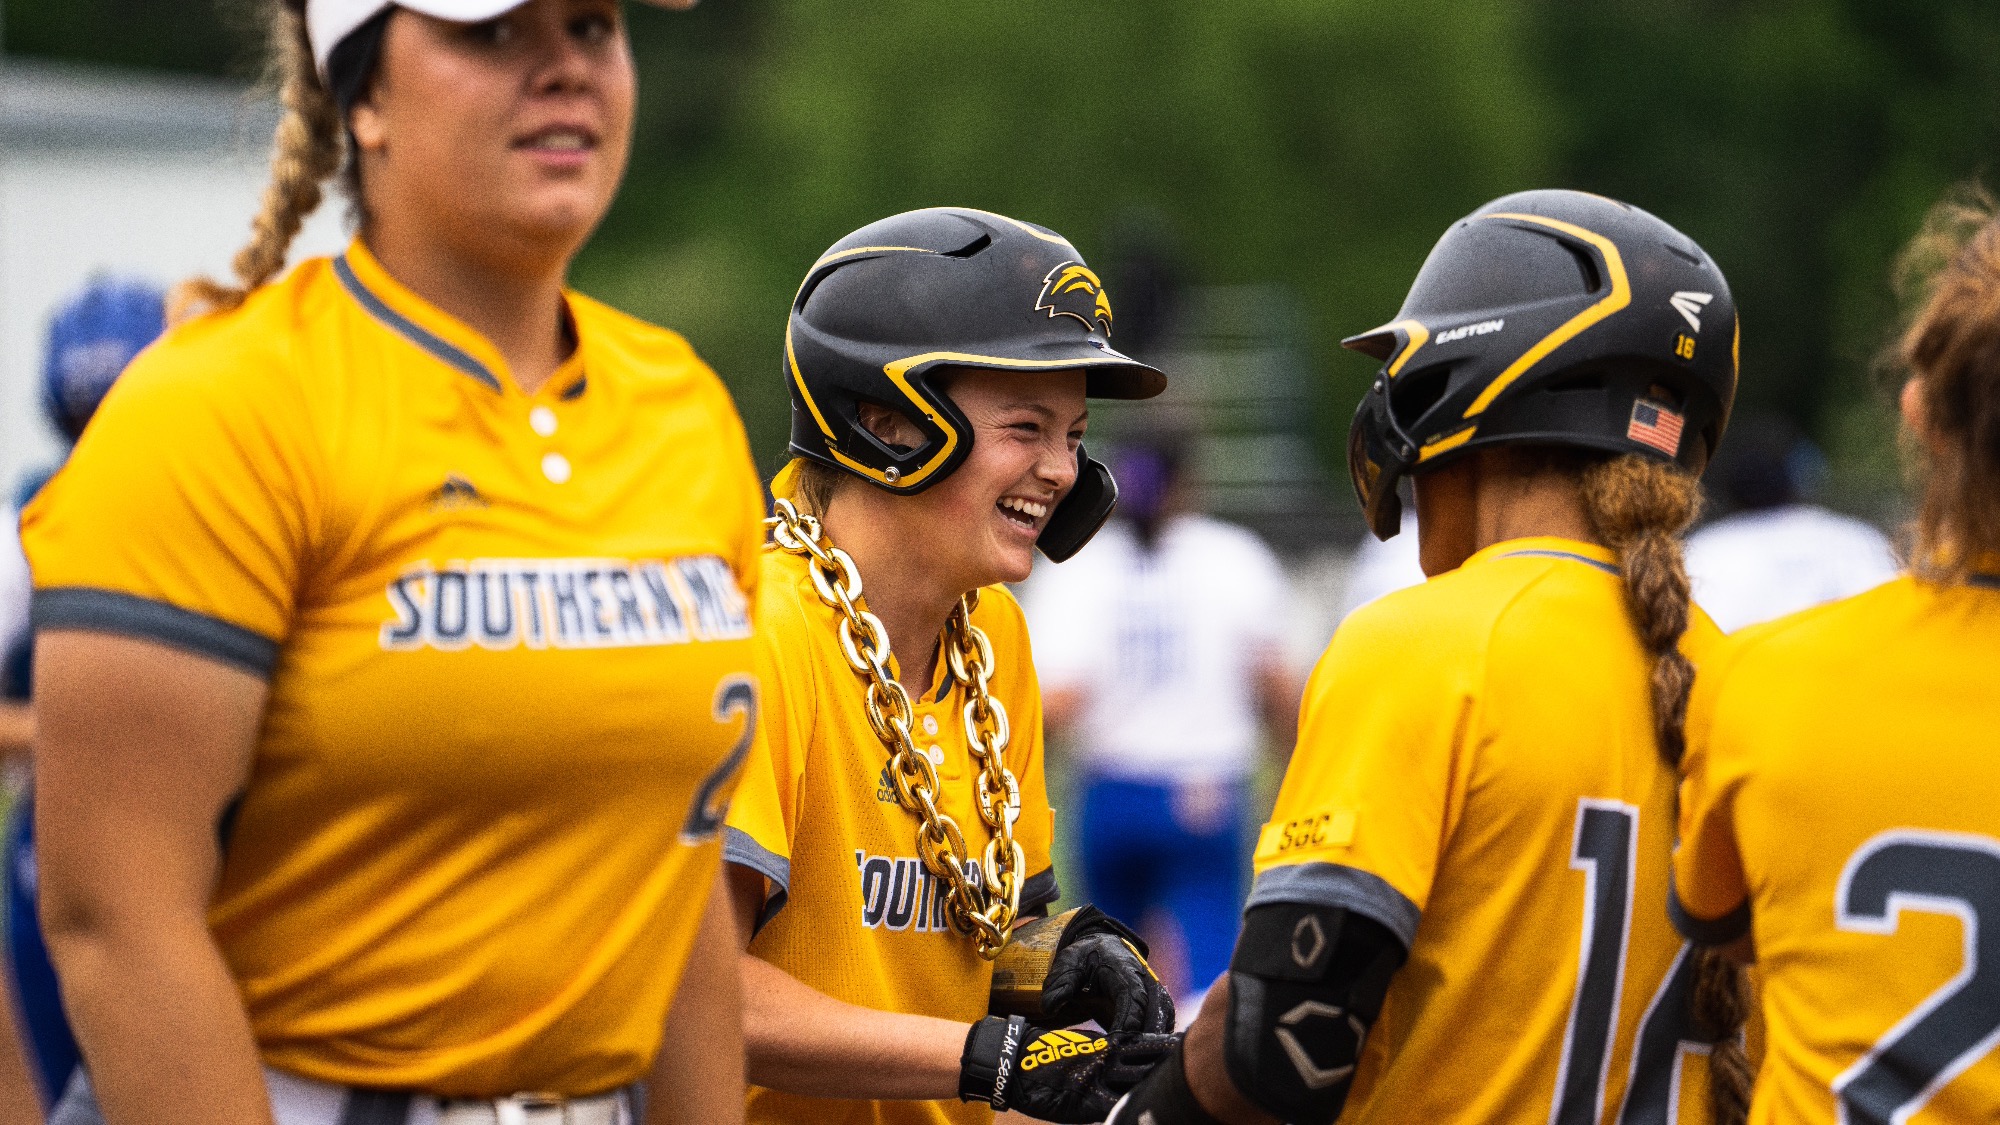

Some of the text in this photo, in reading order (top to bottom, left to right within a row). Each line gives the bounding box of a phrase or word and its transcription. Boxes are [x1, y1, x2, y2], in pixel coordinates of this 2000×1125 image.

[1435, 318, 1505, 346] EASTON
[1675, 333, 1697, 361] 16
[379, 558, 692, 651] SOUTHERN
[678, 671, 760, 847] 2
[1279, 814, 1331, 852] SGC
[992, 1023, 1020, 1108] I AM SECOND
[1020, 1036, 1108, 1072] adidas
